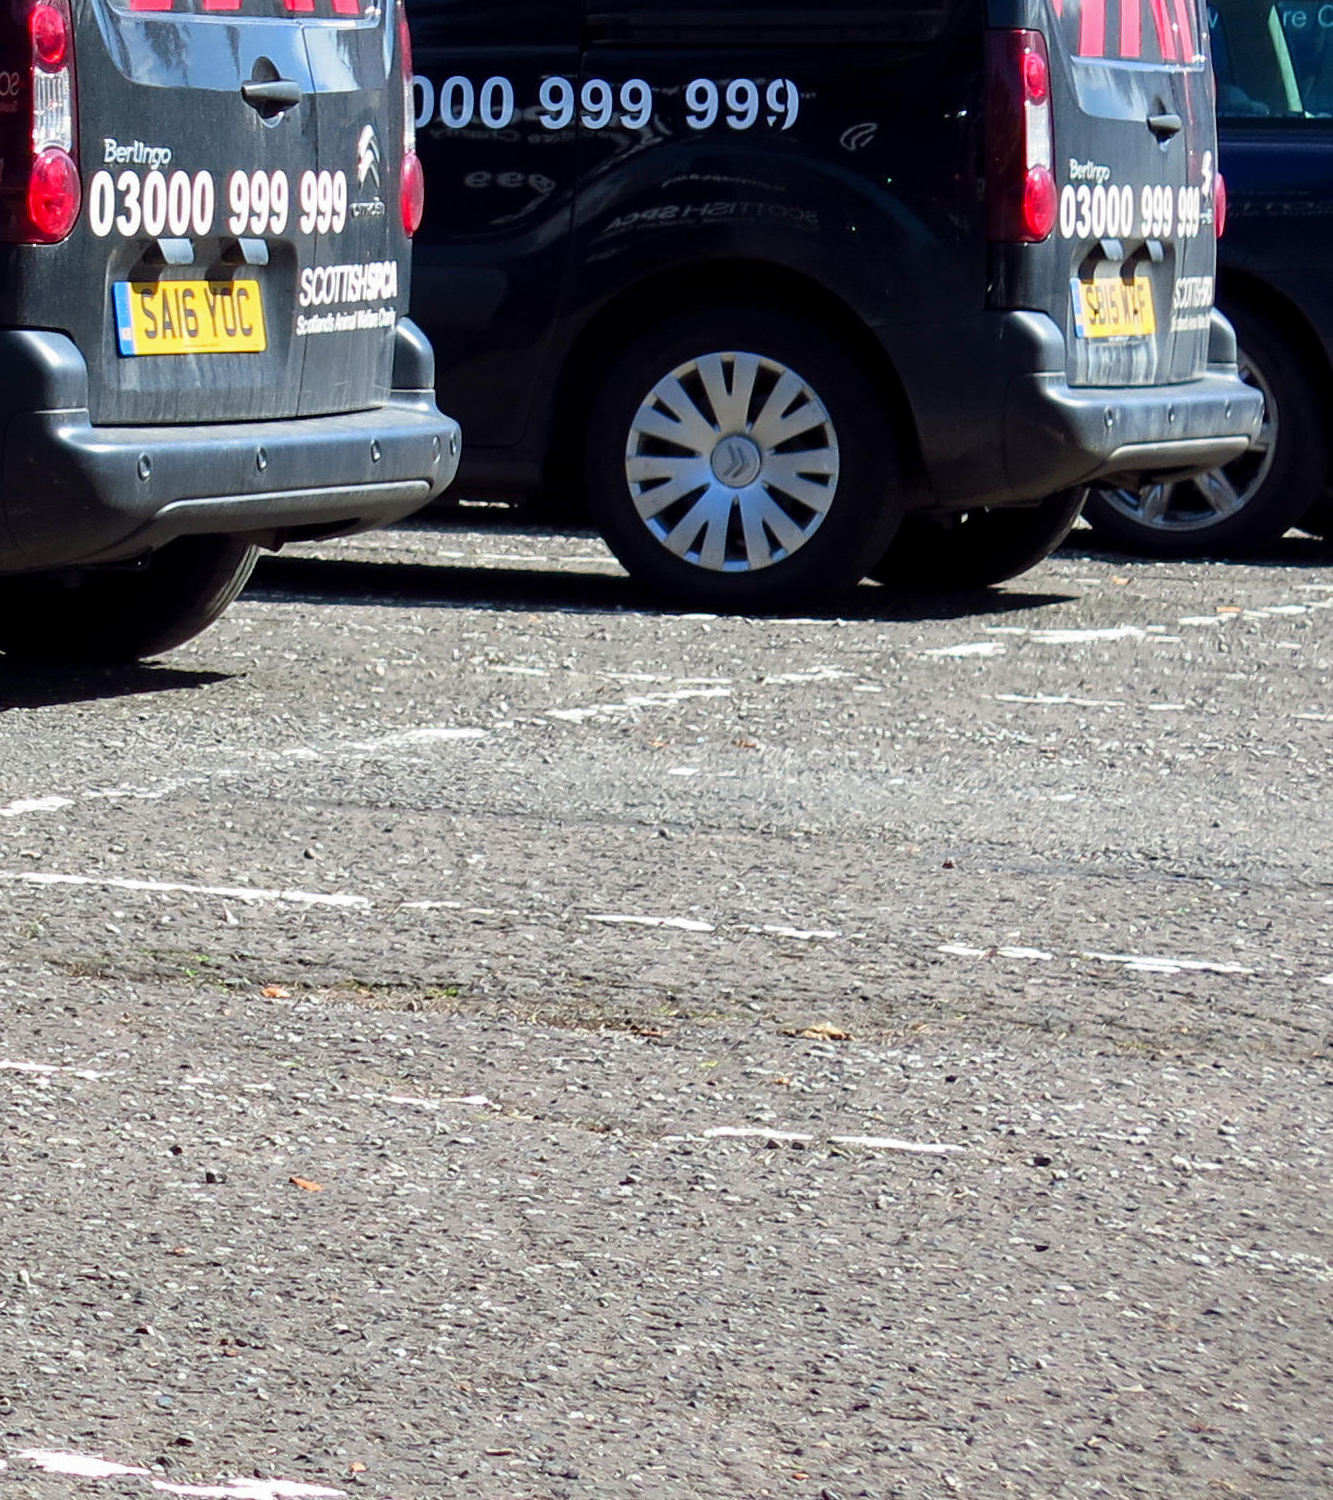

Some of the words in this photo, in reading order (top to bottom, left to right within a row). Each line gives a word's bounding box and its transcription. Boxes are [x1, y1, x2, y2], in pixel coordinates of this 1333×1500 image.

[539, 76, 654, 131] 999
[685, 77, 800, 131] 999
[103, 137, 172, 169] Berlingo
[89, 169, 215, 238] 03000
[228, 169, 289, 236] 999
[300, 169, 347, 235] 999
[1059, 183, 1134, 240] 03000
[1140, 184, 1174, 239] 999
[140, 287, 199, 340] SA16
